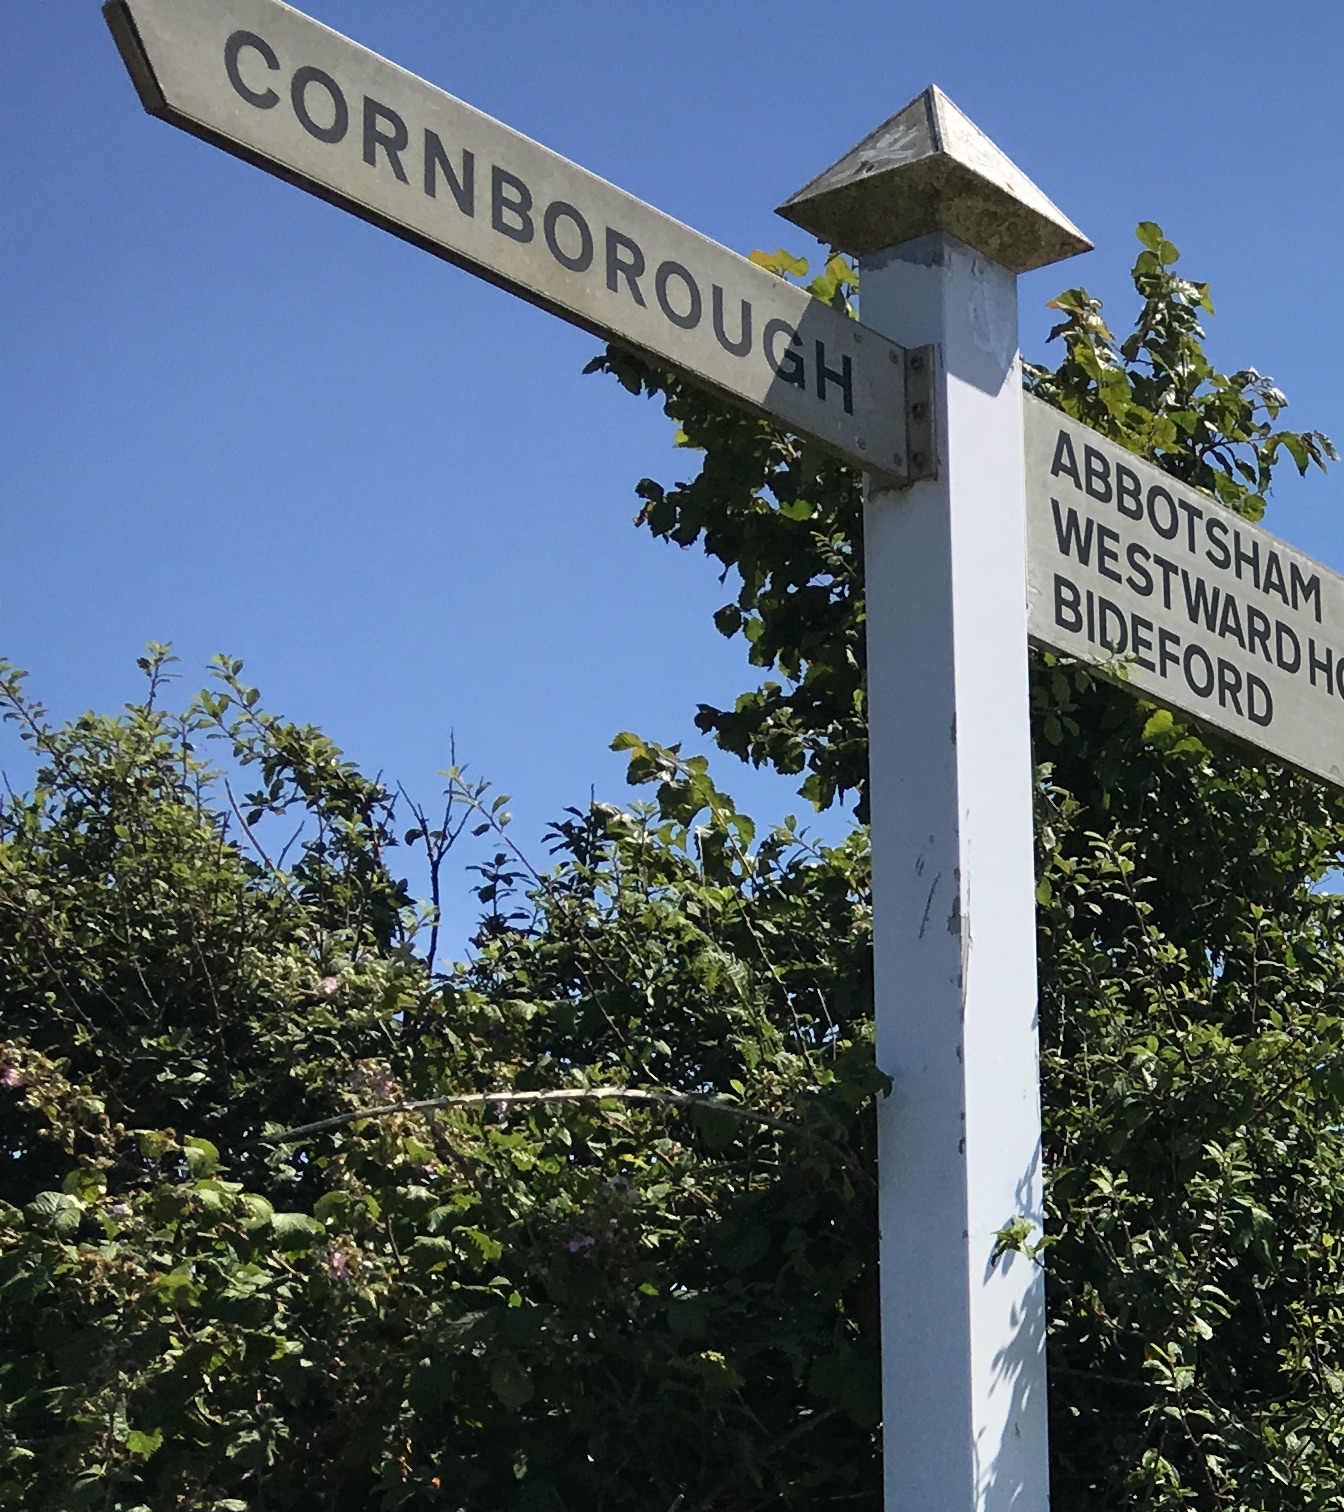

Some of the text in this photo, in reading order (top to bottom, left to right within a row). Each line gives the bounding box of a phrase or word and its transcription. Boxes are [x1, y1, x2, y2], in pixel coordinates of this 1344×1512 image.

[223, 29, 855, 417] CORNBOROUGH
[1050, 430, 1322, 624] ABBOTSHAM
[1050, 497, 1301, 674] WESTWARD
[1053, 573, 1274, 728] BIDEFORD
